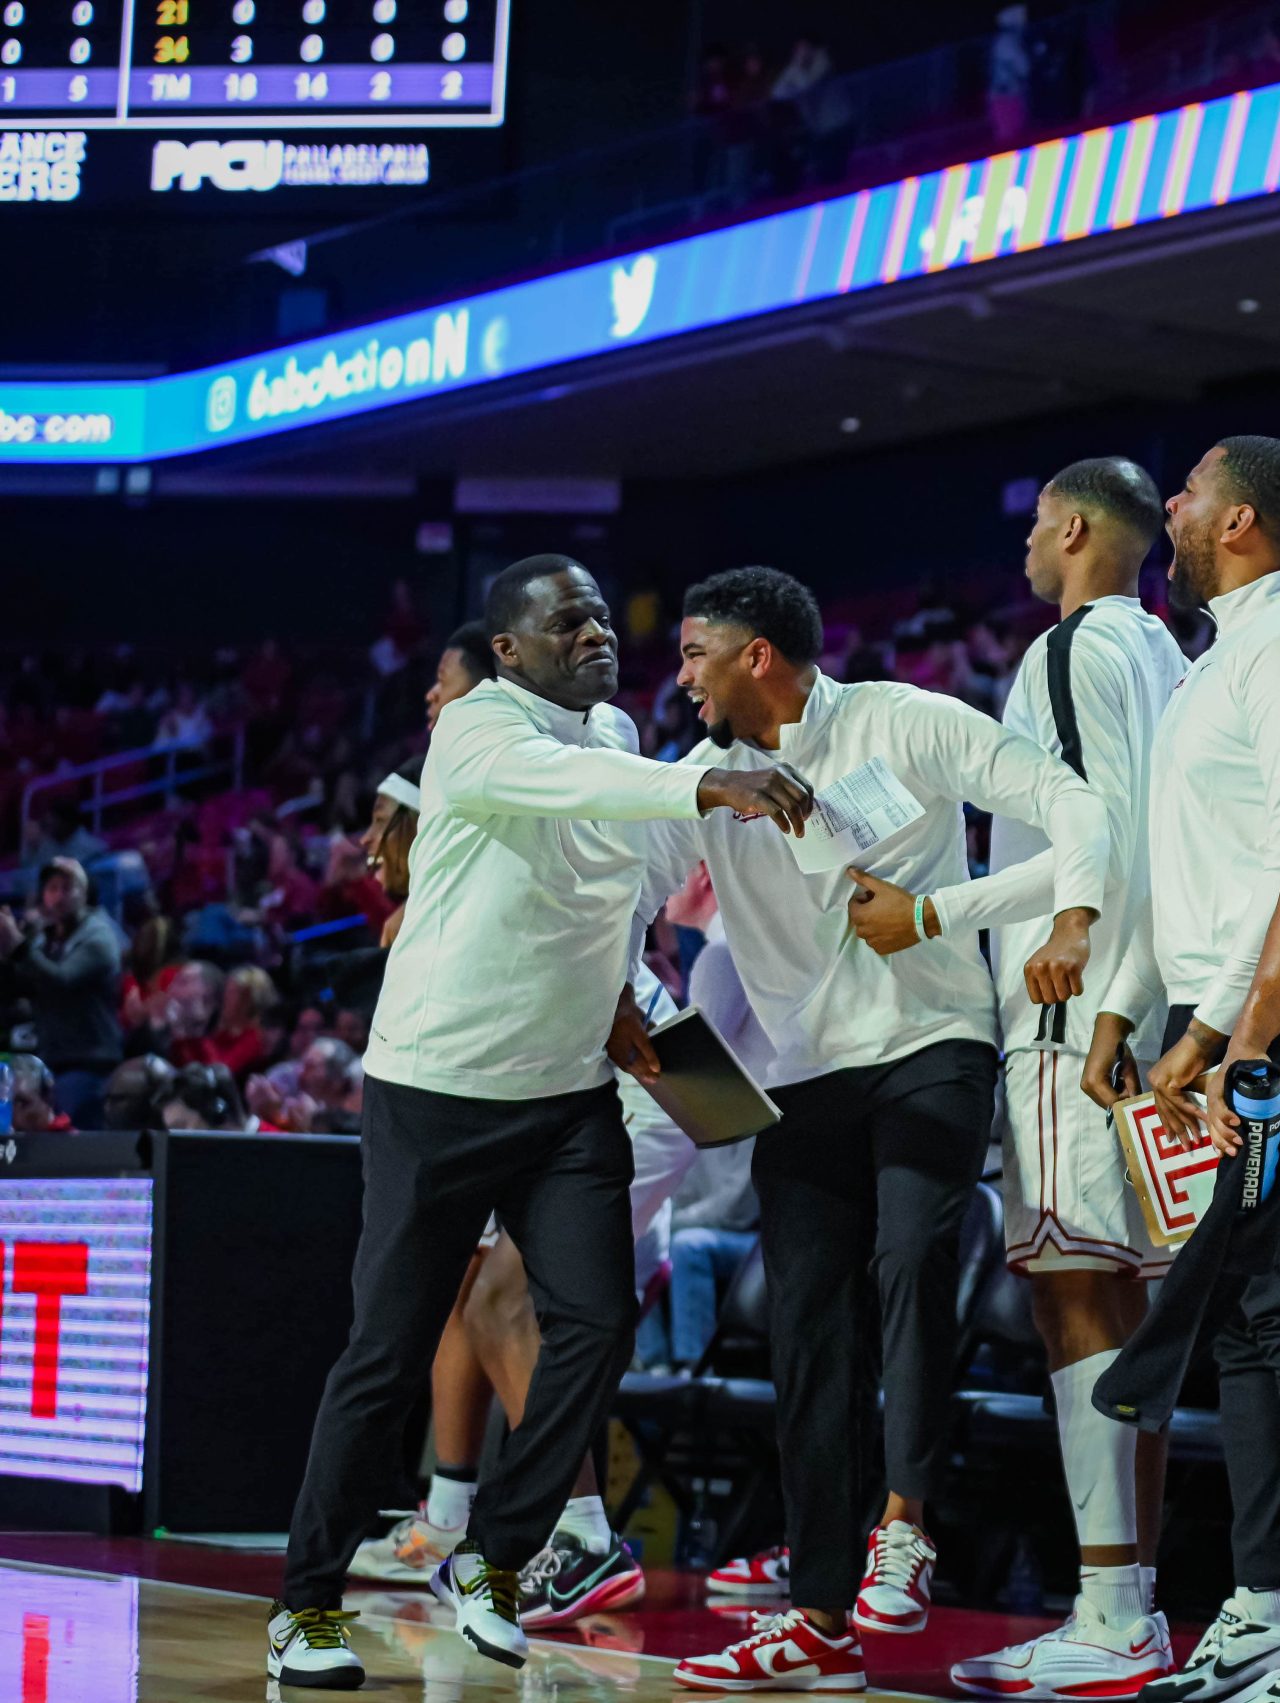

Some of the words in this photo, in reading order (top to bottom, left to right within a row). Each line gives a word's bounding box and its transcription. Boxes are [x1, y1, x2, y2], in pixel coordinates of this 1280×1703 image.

[156, 0, 189, 25] 21
[230, 35, 253, 63] 3
[1241, 1121, 1264, 1209] POWERADE
